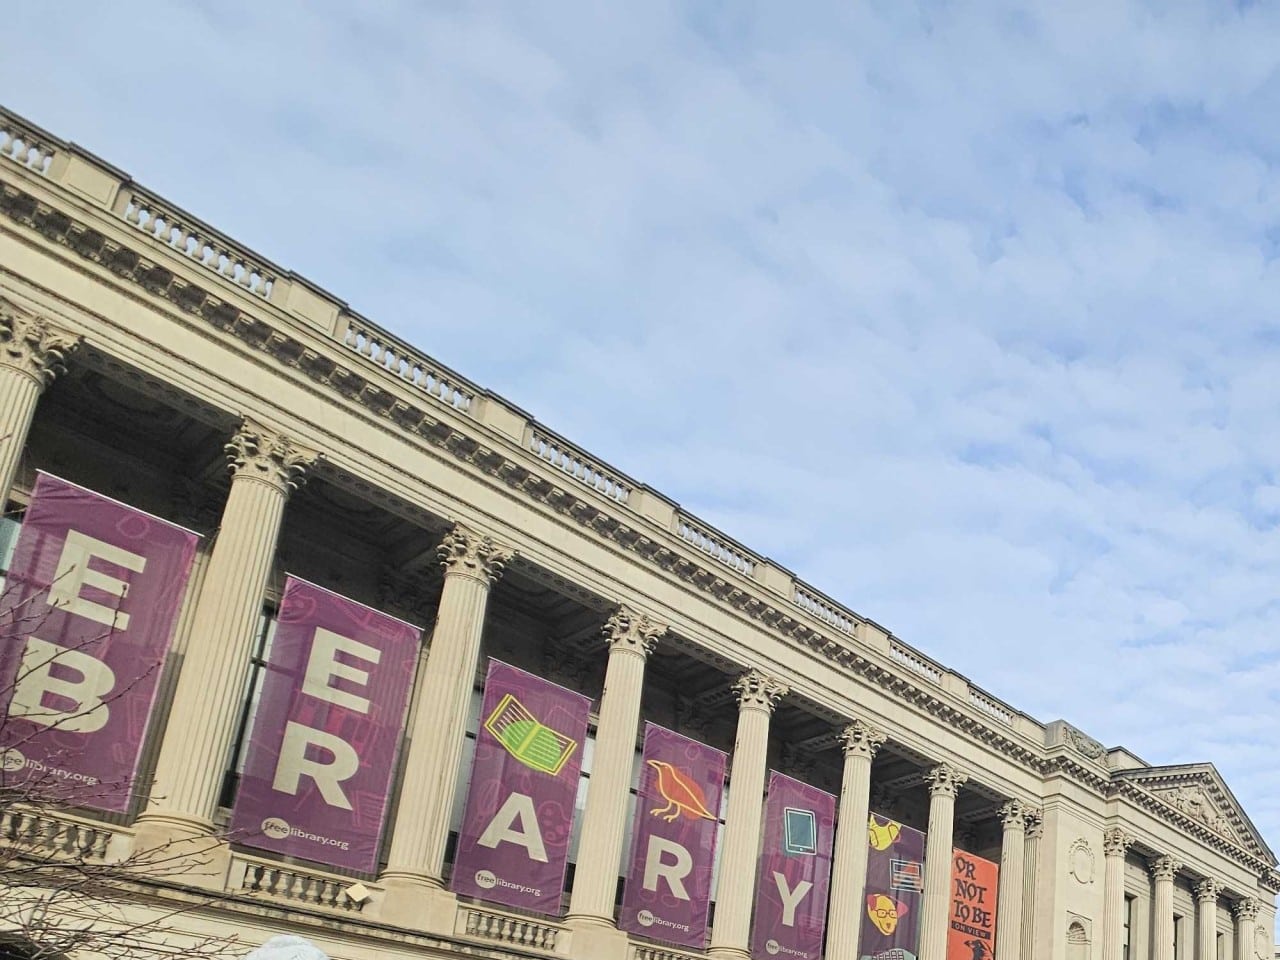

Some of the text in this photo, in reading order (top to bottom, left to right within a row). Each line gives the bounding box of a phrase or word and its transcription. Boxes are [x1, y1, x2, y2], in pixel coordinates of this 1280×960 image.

[477, 791, 549, 863] A
[642, 833, 693, 901] R
[955, 856, 977, 881] OR
[772, 871, 814, 927] Y
[955, 878, 987, 904] NOT
[953, 899, 991, 928] TO BE
[954, 922, 988, 938] ON VIEW
